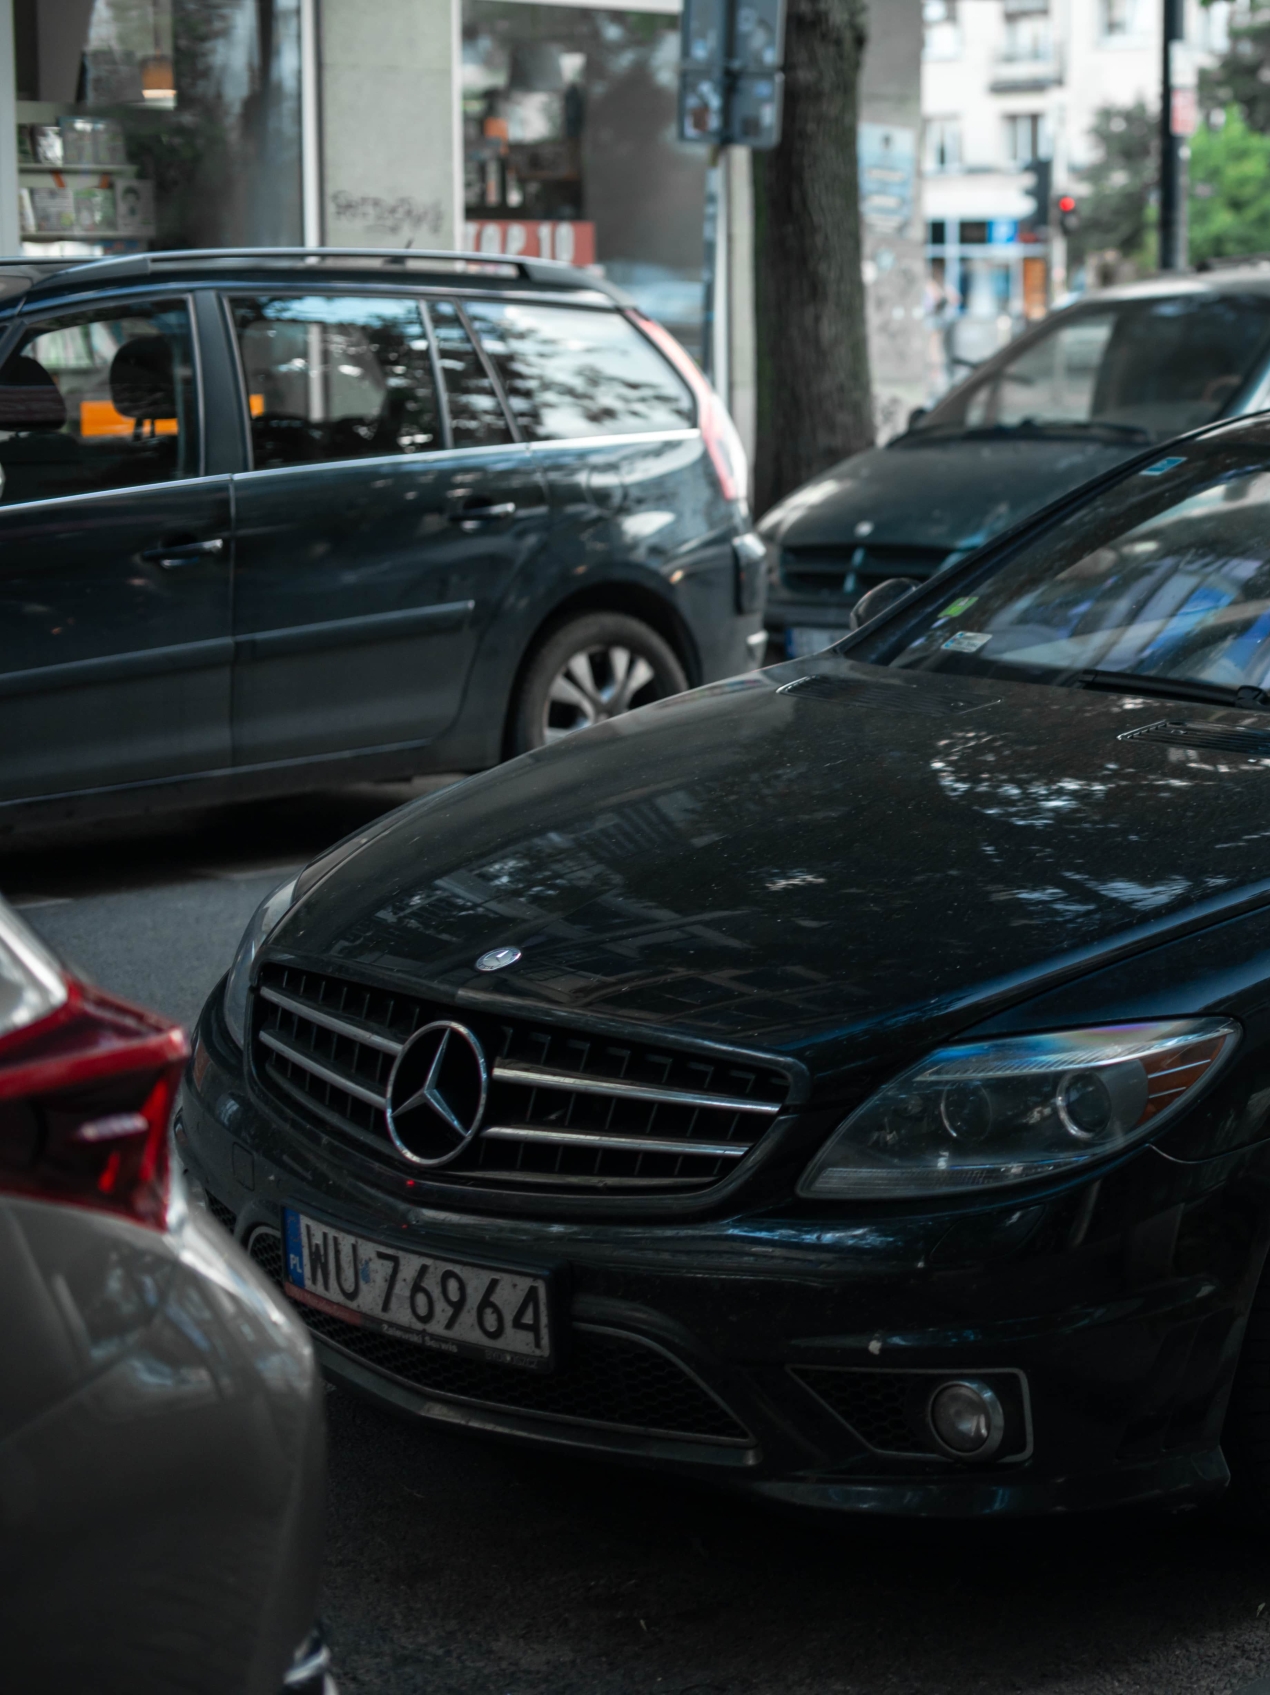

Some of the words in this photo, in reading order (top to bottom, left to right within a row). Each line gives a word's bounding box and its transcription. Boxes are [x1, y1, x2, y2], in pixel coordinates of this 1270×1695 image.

[538, 221, 575, 262] 10
[289, 1253, 302, 1273] PL
[305, 1223, 361, 1302] WU
[376, 1250, 542, 1350] 76964
